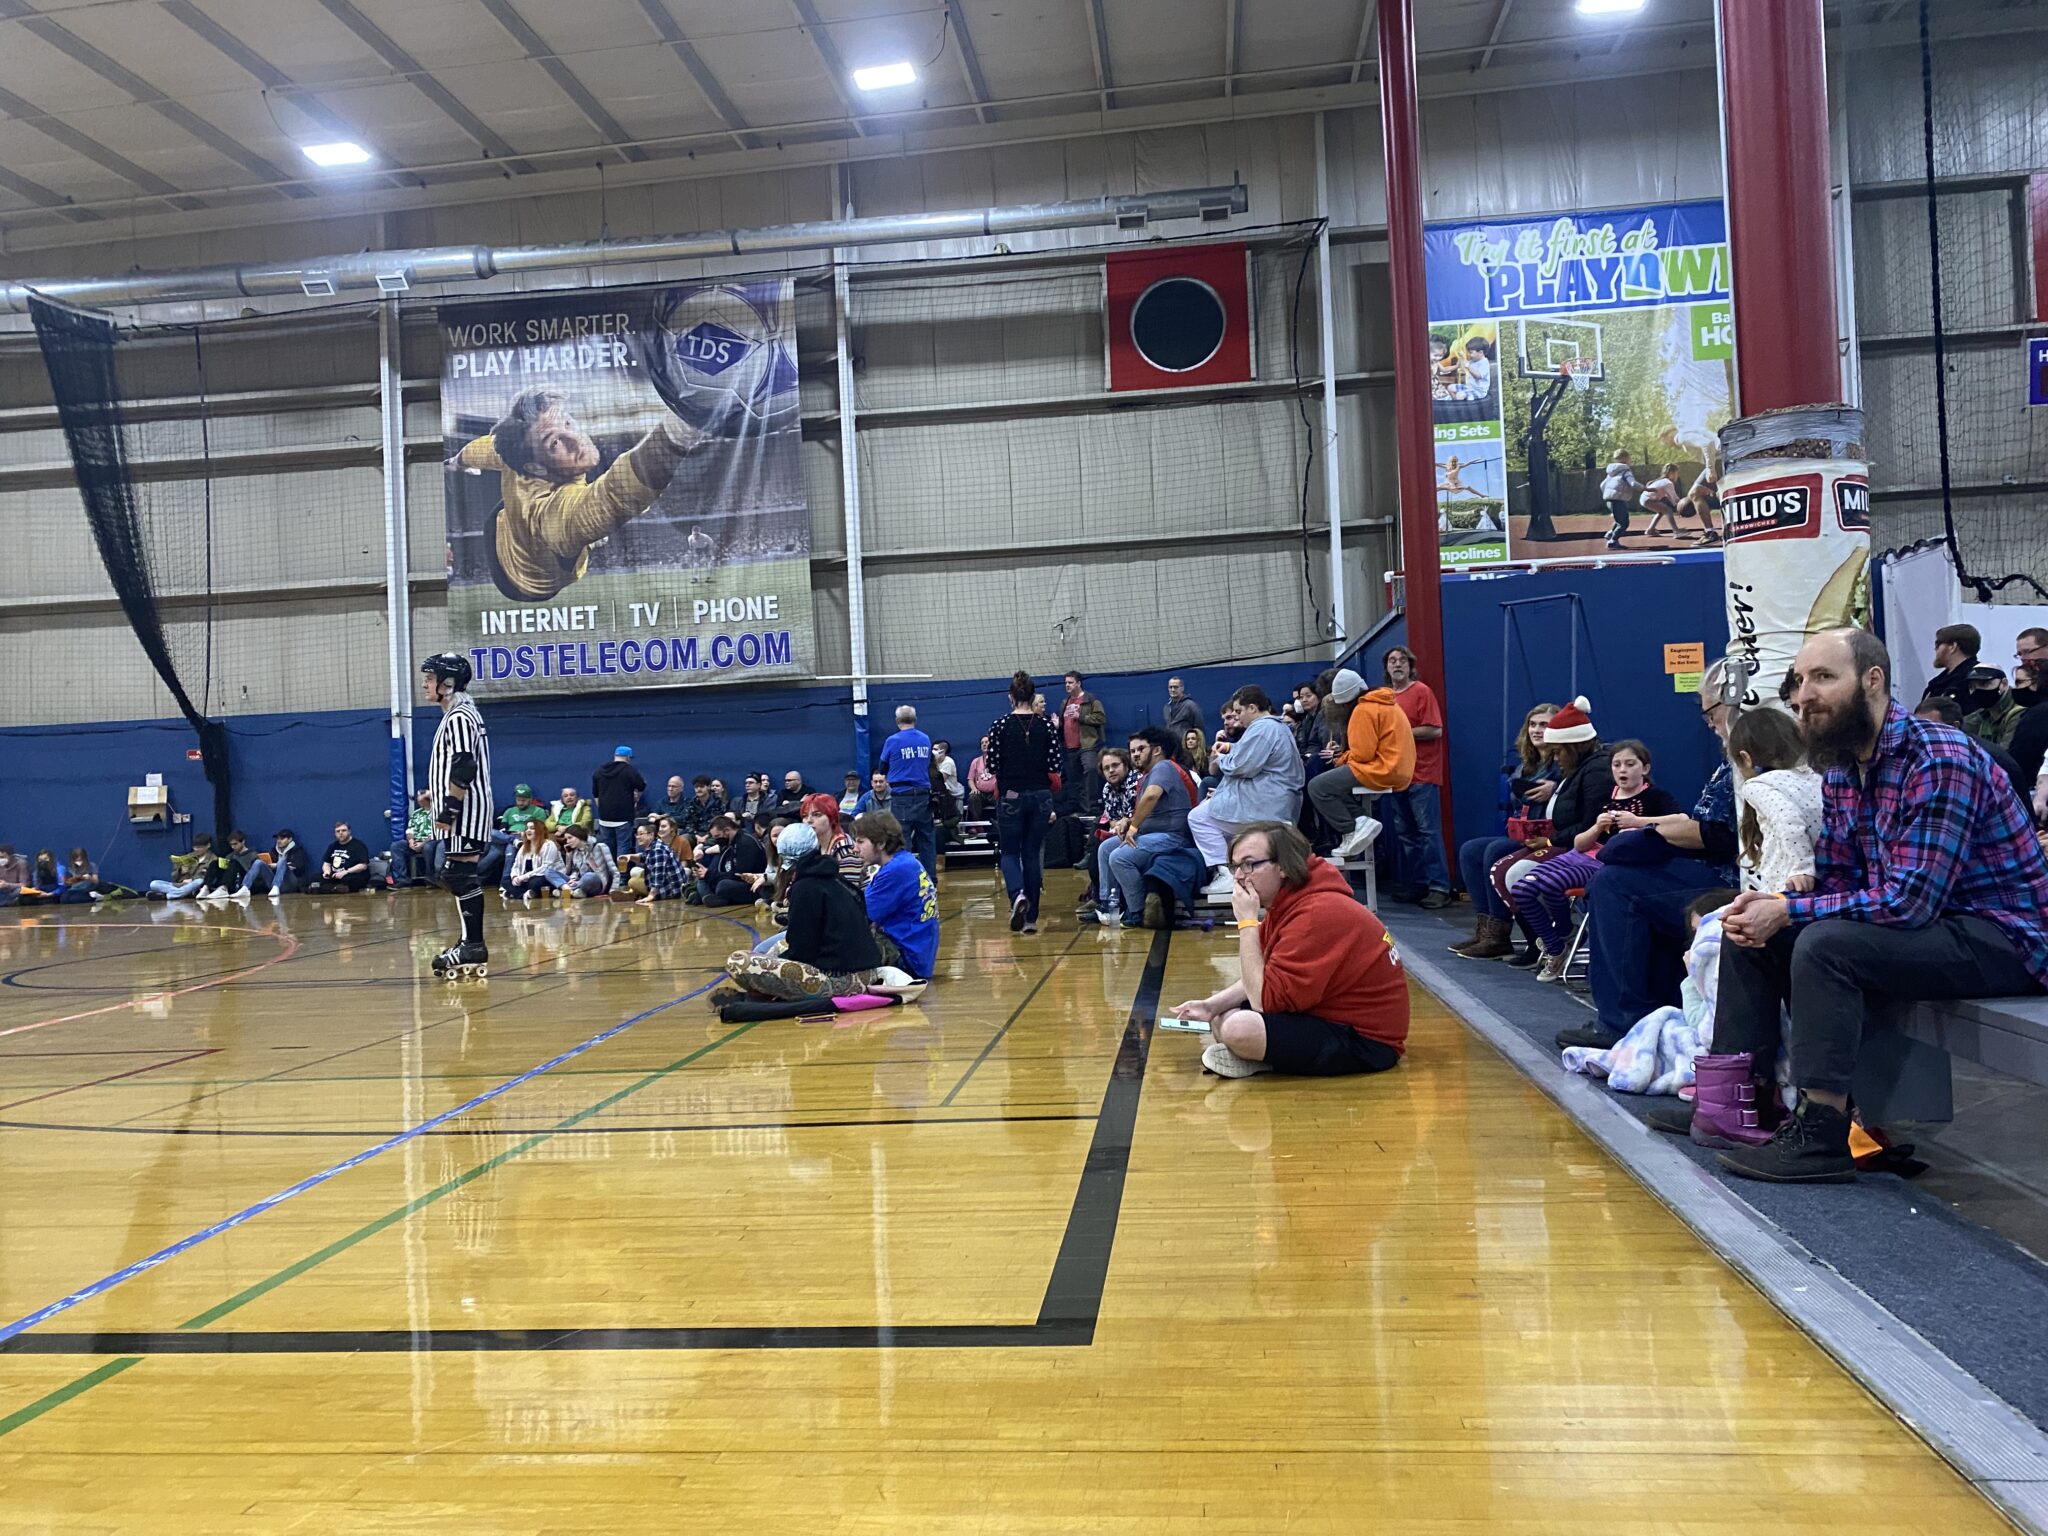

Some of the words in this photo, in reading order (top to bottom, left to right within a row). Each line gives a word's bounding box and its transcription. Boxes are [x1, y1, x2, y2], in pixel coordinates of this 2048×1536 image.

[1456, 231, 1511, 277] Try
[1515, 229, 1544, 262] it
[1541, 217, 1617, 277] first
[1621, 219, 1658, 251] at
[448, 321, 518, 348] WORK
[526, 313, 636, 342] SMARTER.
[453, 350, 514, 378] PLAY
[525, 342, 637, 374] HARDER.
[687, 335, 732, 364] TDS
[1459, 425, 1490, 437] Sets
[481, 605, 598, 635] INTERNET
[629, 601, 660, 627] TV
[693, 595, 779, 624] PHONE
[469, 630, 793, 681] TDSTELECOM.COM
